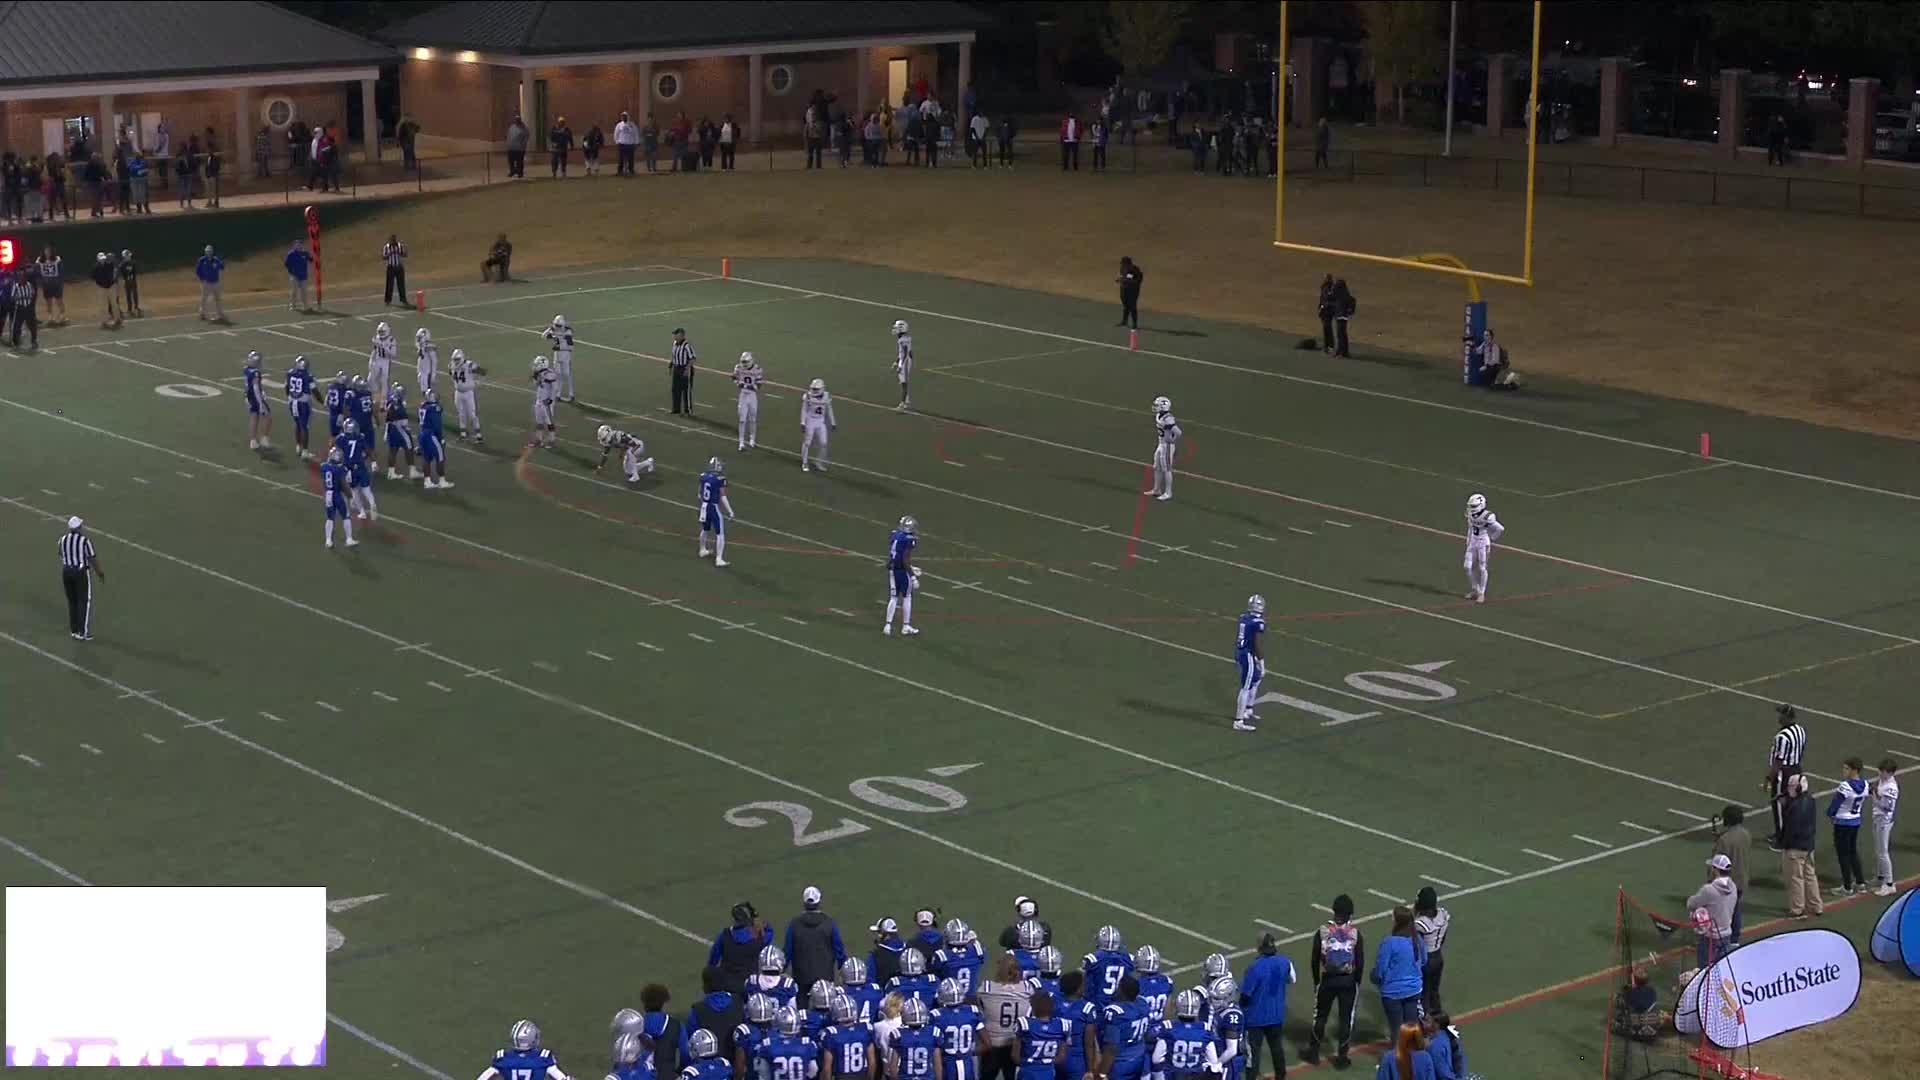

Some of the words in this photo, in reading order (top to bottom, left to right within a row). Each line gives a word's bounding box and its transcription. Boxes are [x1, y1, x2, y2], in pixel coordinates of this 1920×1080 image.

[289, 377, 303, 393] 59
[348, 440, 356, 459] 7
[325, 471, 332, 488] 8
[703, 482, 711, 501] 6
[1254, 671, 1457, 727] 10
[724, 776, 967, 847] 20
[1741, 962, 1840, 1006] SouthState
[859, 1000, 870, 1023] 4
[1000, 1003, 1019, 1028] 61
[945, 1024, 972, 1055] 30
[844, 1042, 864, 1073] 18
[907, 1047, 928, 1075] 19
[1171, 1040, 1202, 1069] 85
